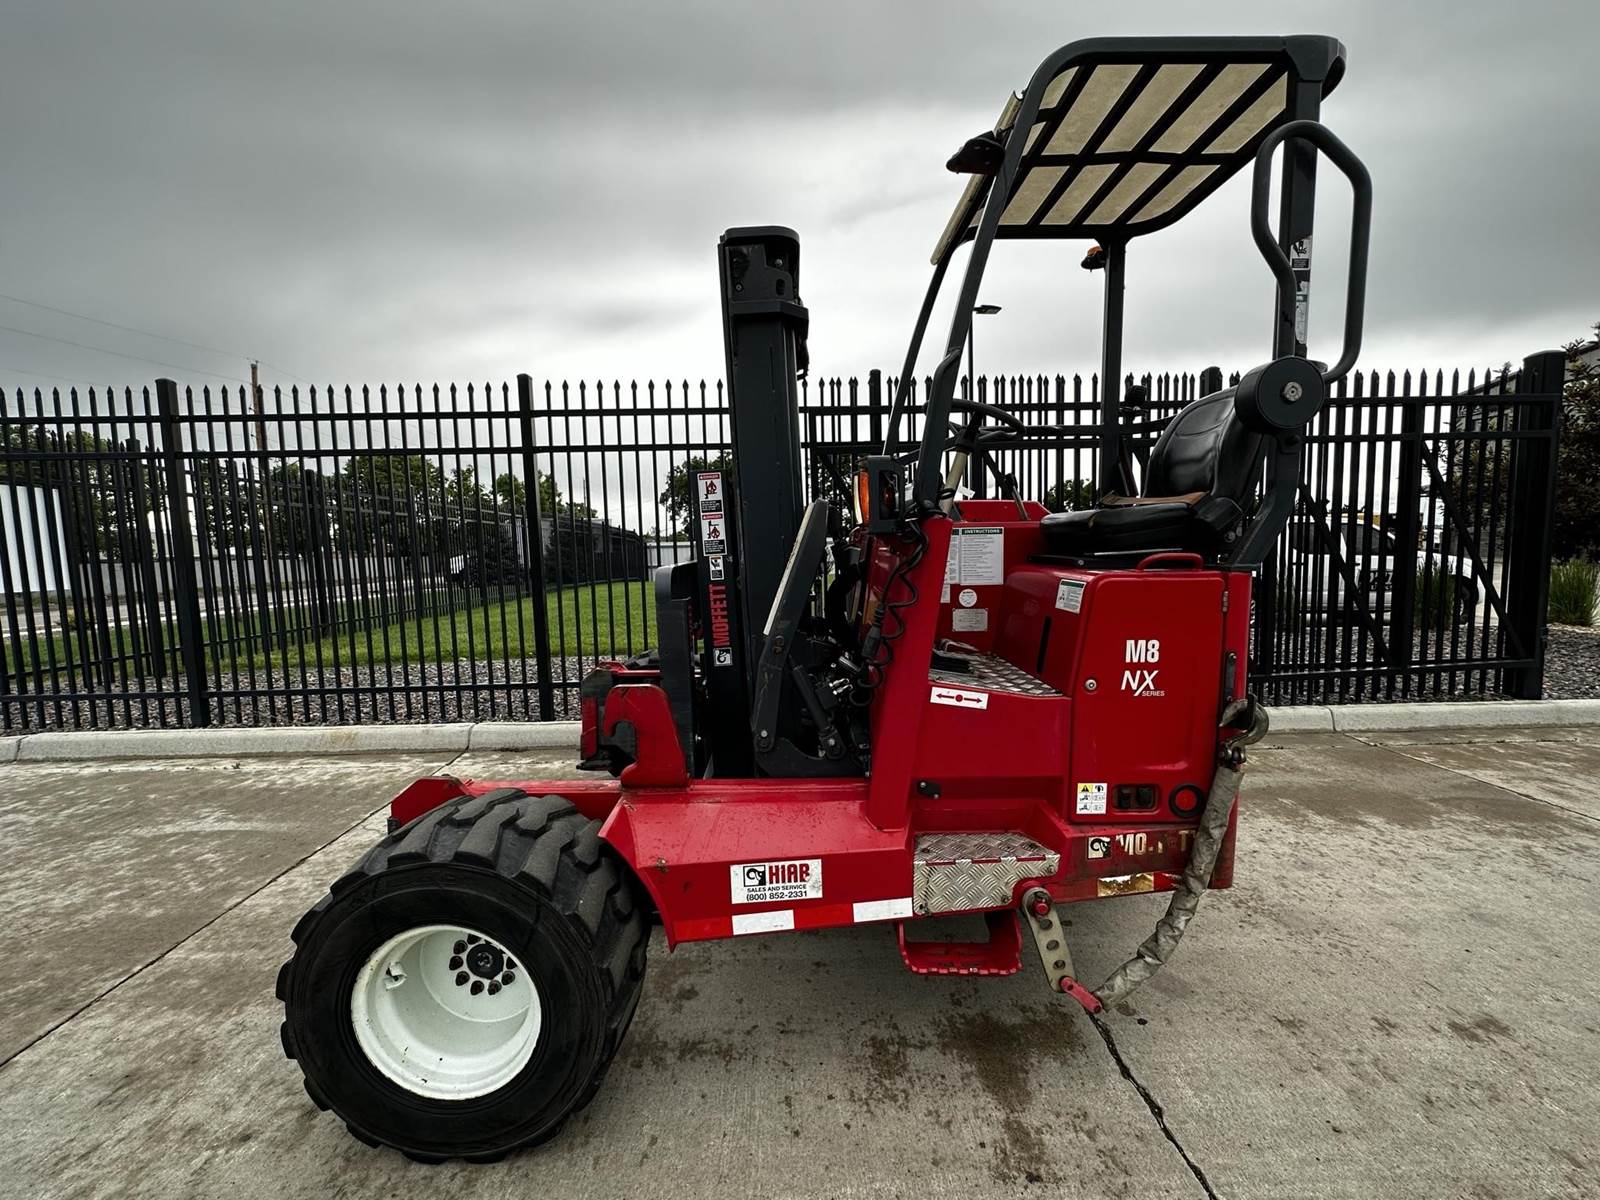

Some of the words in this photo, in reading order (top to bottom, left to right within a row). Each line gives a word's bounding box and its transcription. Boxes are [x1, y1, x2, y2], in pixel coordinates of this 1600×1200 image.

[709, 584, 730, 647] MOFFETT
[1125, 639, 1160, 663] M8
[1120, 670, 1159, 697] NX
[746, 893, 767, 901] (800)
[769, 890, 808, 900] 852-2331
